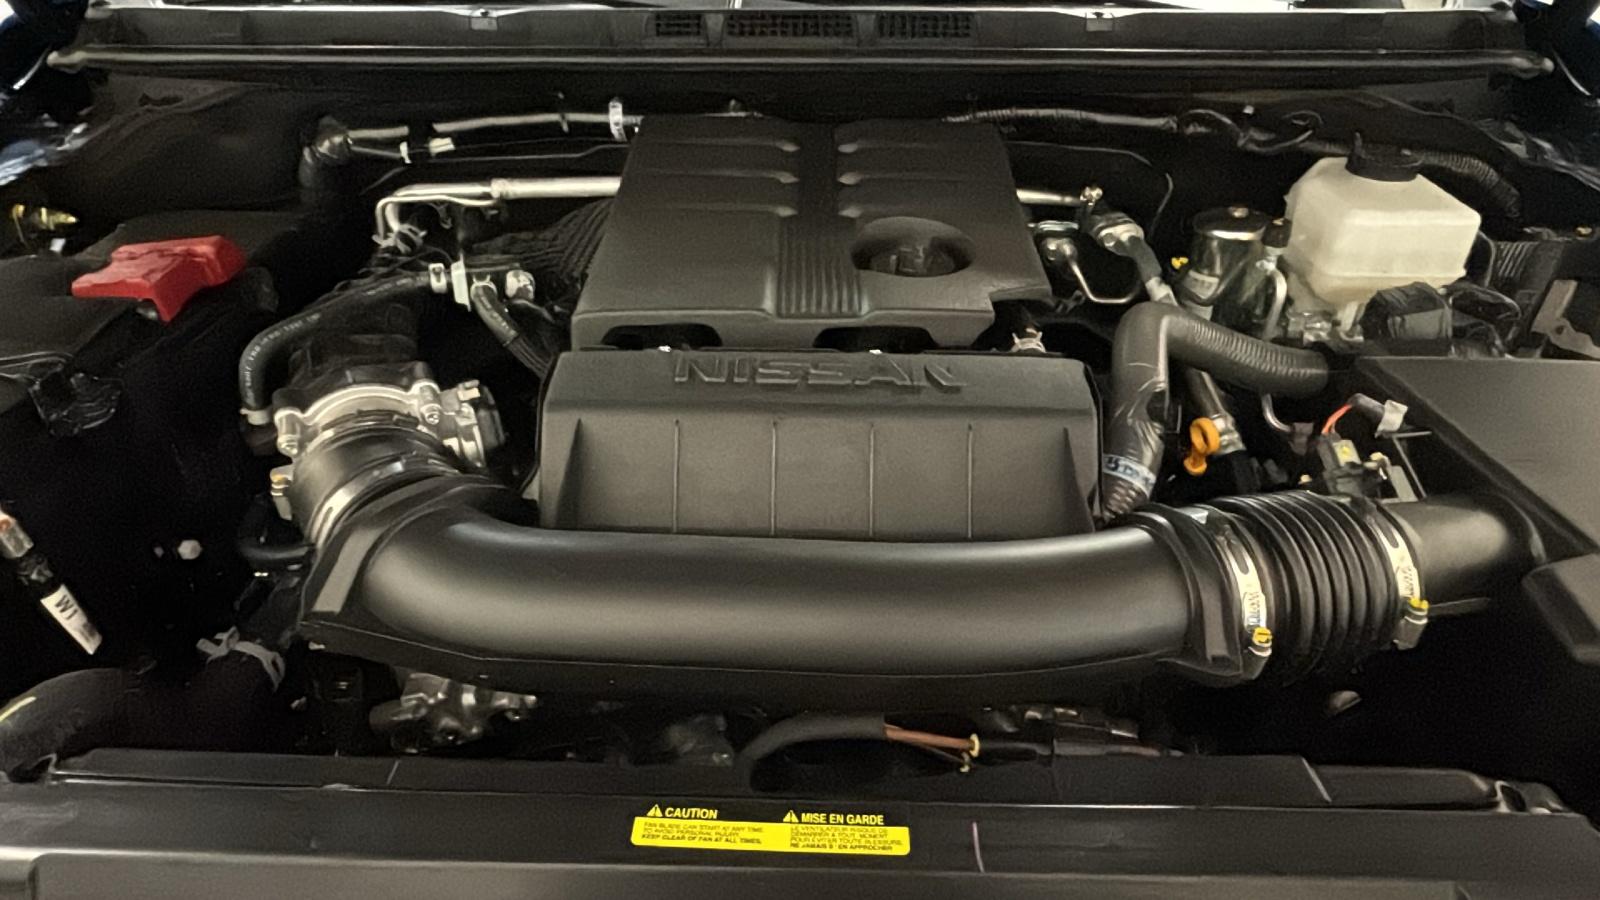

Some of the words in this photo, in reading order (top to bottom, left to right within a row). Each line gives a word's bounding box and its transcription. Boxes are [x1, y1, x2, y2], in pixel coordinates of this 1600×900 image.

[674, 351, 966, 388] NISSAN
[664, 807, 719, 819] CAUTION
[801, 812, 827, 823] MISE
[829, 813, 844, 824] EN
[846, 814, 884, 825] GARDE
